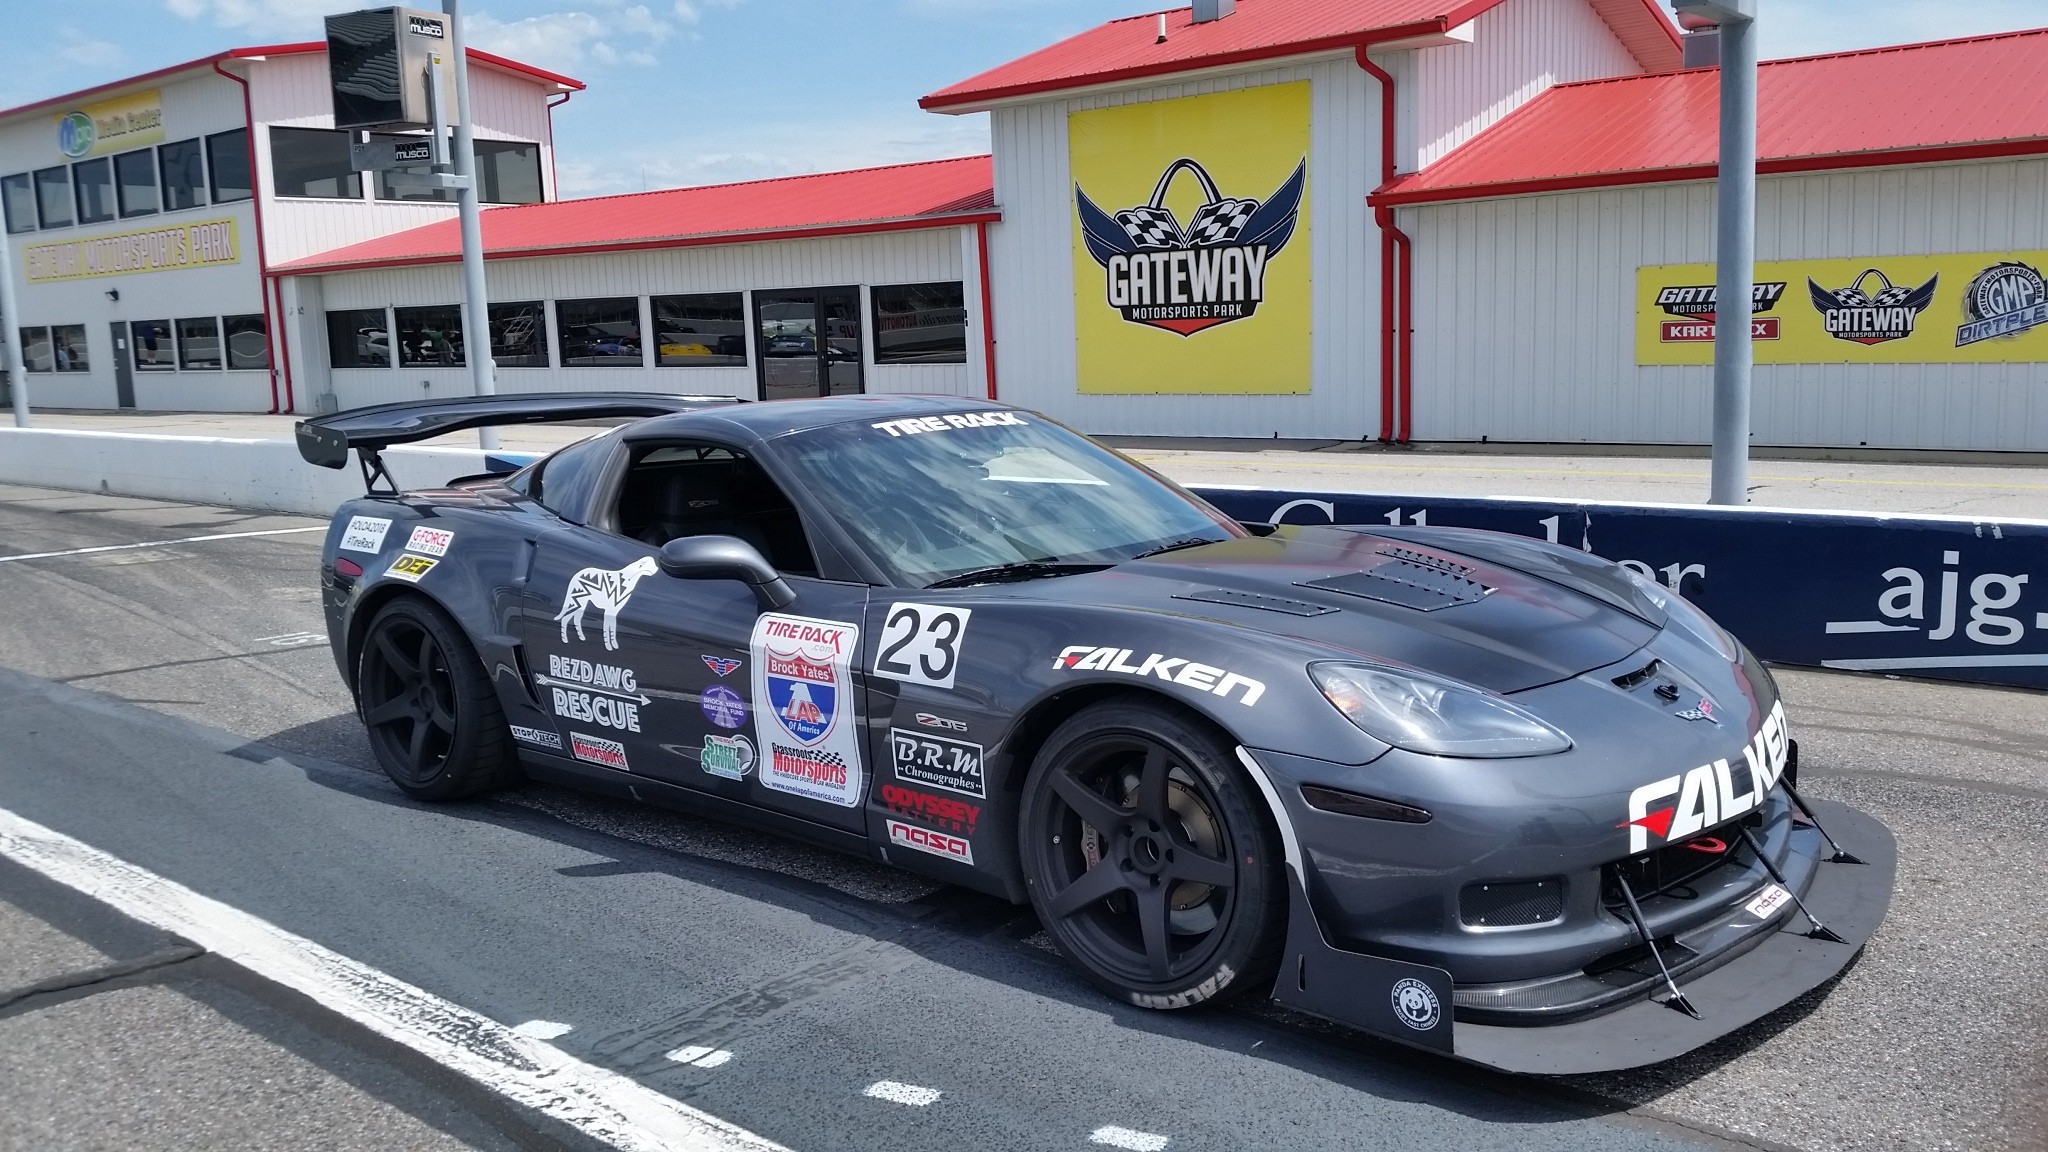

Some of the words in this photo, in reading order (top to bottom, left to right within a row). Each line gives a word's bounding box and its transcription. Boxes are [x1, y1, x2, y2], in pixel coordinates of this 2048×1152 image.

[84, 228, 188, 275] MOTORSPORTS
[190, 221, 235, 264] PARK
[1108, 245, 1268, 306] GATEWAY
[1988, 275, 2035, 314] GMP
[1132, 304, 1209, 320] MOTORSPORTS
[1213, 303, 1243, 317] PARK
[1826, 307, 1917, 332] GATEWAY
[871, 416, 952, 437] TIRE
[944, 412, 1029, 429] RACK
[347, 535, 375, 549] #TireRack
[408, 541, 427, 552] RACING
[427, 543, 443, 554] GEAR
[413, 529, 450, 547] G-FORCE
[766, 621, 800, 639] TIRE
[799, 626, 844, 655] RACK
[812, 643, 834, 654] .com
[877, 608, 960, 681] 23
[549, 654, 637, 693] REZDAWG
[771, 660, 798, 676] Brock
[1051, 645, 1266, 707] FALKEN
[552, 687, 641, 733] RESCUE
[703, 697, 724, 706] BROCK
[725, 701, 742, 710] YATES
[730, 709, 744, 717] FUND
[785, 699, 821, 725] LAP
[788, 721, 797, 731] Of
[797, 723, 820, 736] America
[575, 743, 625, 766] Motorsports
[705, 736, 737, 756] STREET
[772, 741, 812, 760] Grassroots
[702, 750, 740, 773] SURVIVAL
[773, 751, 847, 785] Motorsports
[1617, 700, 1789, 854] FALKEN
[772, 782, 846, 804] www.onelapofamerica.com
[882, 785, 980, 824] ODYSSEY
[888, 803, 976, 835] BATTERY
[1394, 981, 1411, 997] PANDA
[1412, 981, 1438, 1008] EXPRESS
